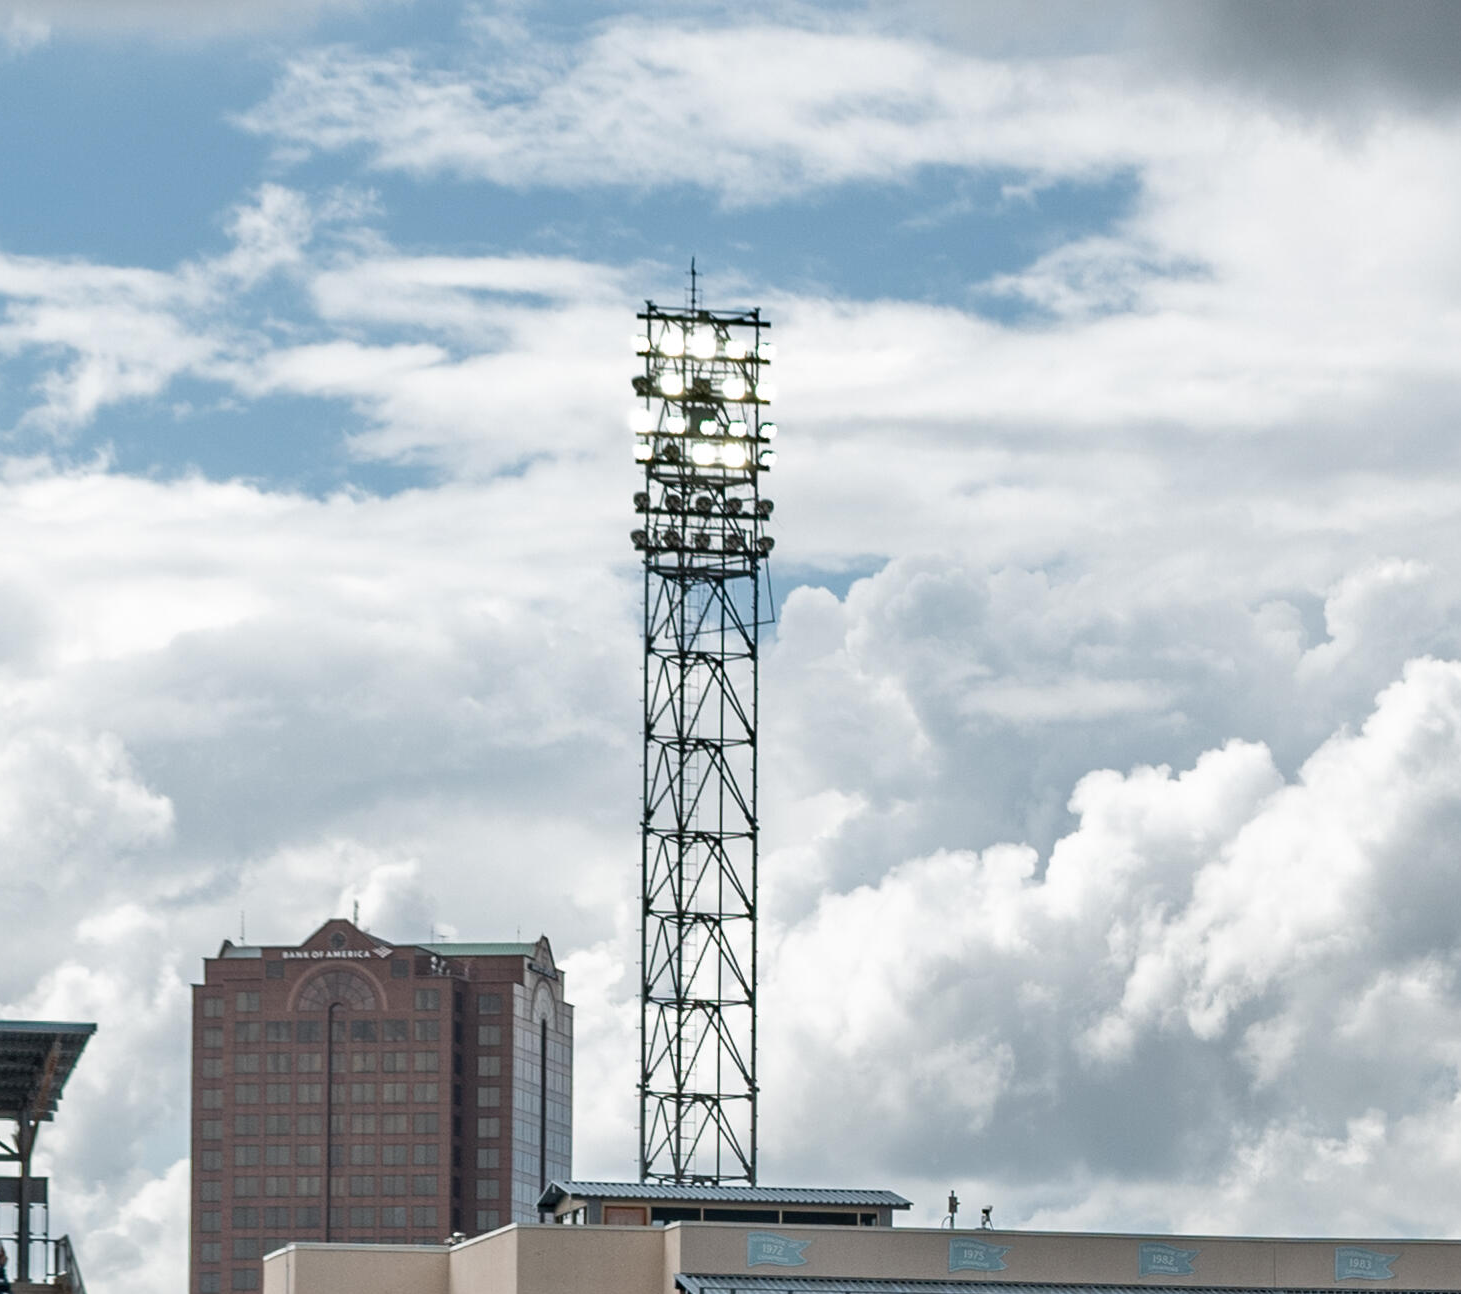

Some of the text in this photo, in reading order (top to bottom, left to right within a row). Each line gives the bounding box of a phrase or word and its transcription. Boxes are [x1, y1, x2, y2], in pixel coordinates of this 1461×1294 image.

[282, 949, 371, 959] BANK OF AMERICA
[762, 1243, 784, 1256] 1972
[963, 1249, 985, 1261] 1975
[1152, 1254, 1175, 1266] 1982
[1349, 1258, 1372, 1270] 1983
